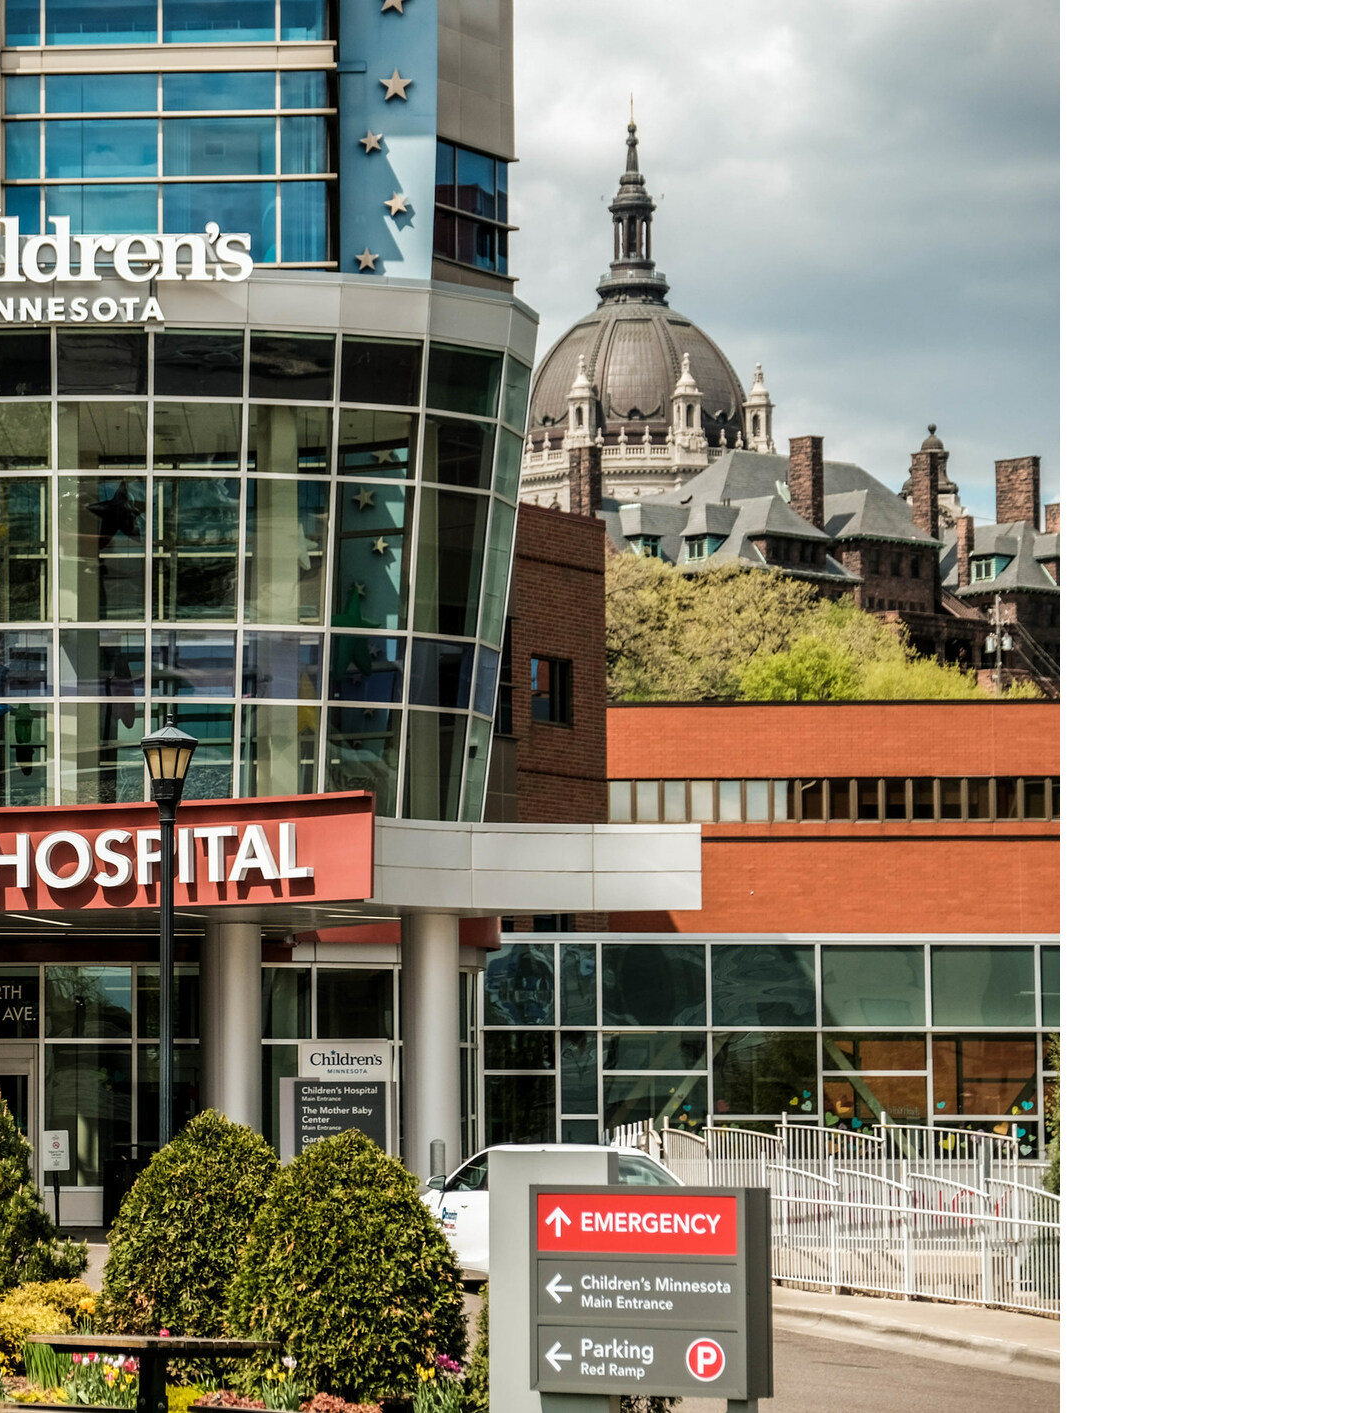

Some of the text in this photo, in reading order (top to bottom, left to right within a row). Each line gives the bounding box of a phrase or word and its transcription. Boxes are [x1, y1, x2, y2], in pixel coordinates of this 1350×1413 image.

[2, 1007, 37, 1022] AVE.
[310, 1050, 383, 1066] Children's
[301, 1086, 378, 1096] Children's Hospital
[302, 1106, 373, 1117] The Mother Baby
[302, 1115, 330, 1124] Center
[581, 1211, 721, 1235] EMERGENCY
[581, 1274, 732, 1294] Children's Minnesota
[581, 1295, 674, 1311] Main Entrance
[581, 1338, 655, 1365] Parking
[697, 1346, 717, 1374] P
[581, 1363, 646, 1380] Red Ramp
